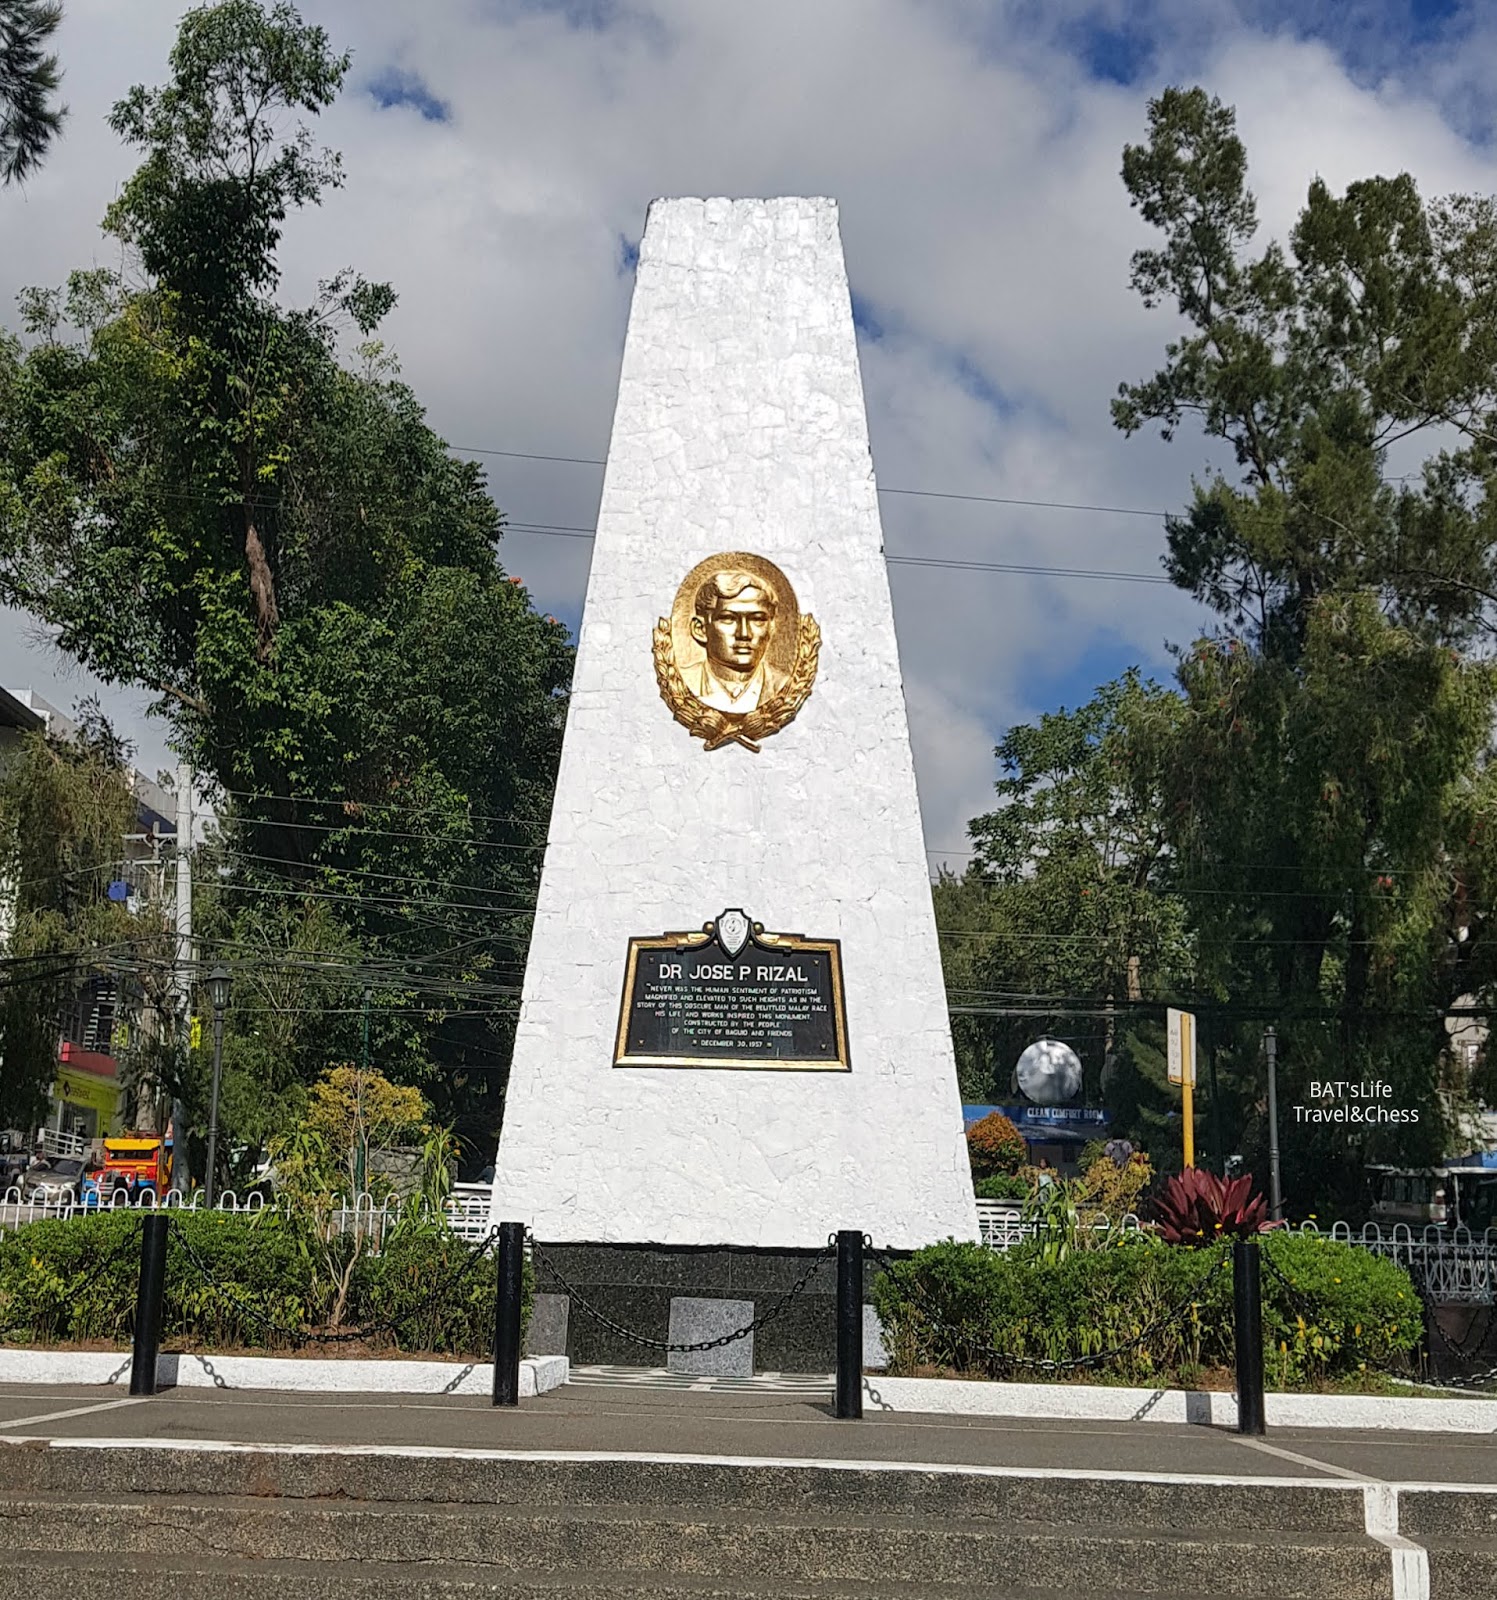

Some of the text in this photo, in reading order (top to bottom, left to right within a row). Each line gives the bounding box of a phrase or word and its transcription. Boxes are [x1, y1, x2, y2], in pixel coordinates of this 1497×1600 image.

[659, 964, 682, 979] DR
[689, 964, 734, 980] JOSE
[756, 966, 808, 982] RIZAL
[1027, 1107, 1104, 1119] CLEAN COMFORT ROOM
